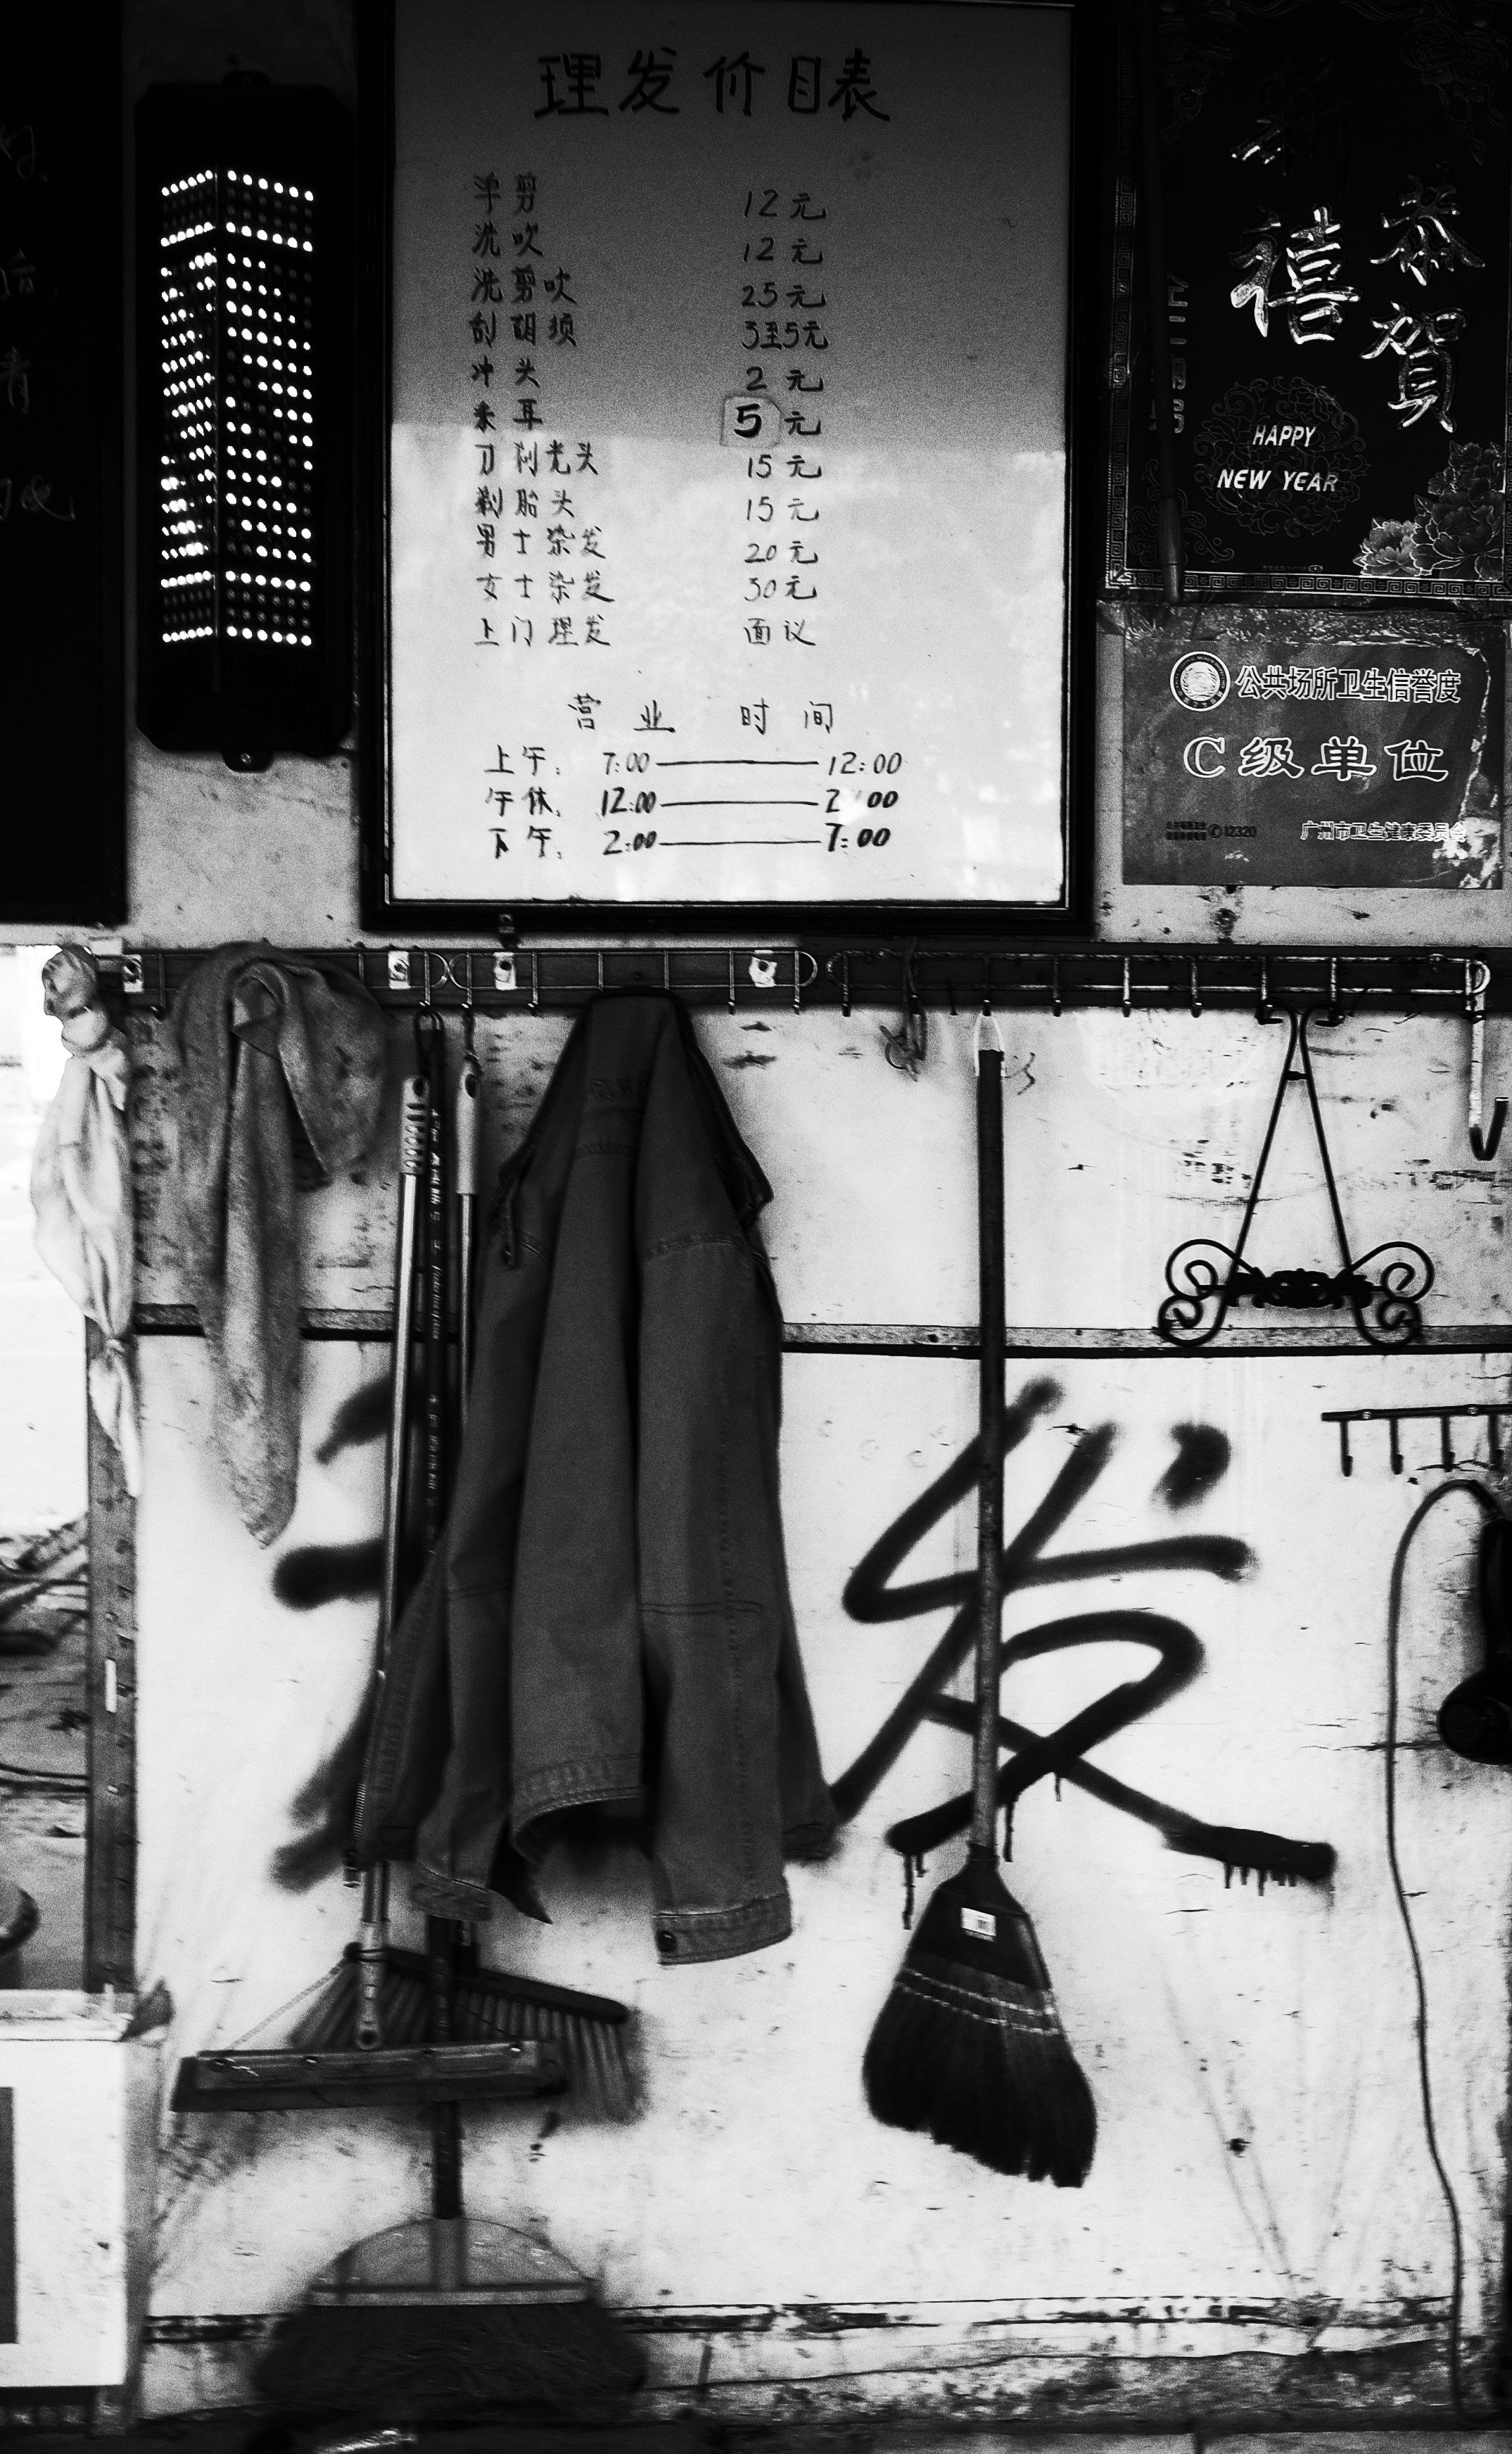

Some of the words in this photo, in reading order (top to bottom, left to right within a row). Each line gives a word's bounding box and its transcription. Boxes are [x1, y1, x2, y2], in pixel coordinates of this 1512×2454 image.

[534, 46, 890, 122] 理发价目表
[471, 221, 544, 258] 洗吹
[471, 265, 578, 305] 洗剪吹
[469, 311, 577, 348] 刮胡须
[742, 320, 830, 350] 3至5元
[471, 355, 540, 388] 冲头
[1252, 424, 1319, 448] HAPPY
[1216, 469, 1273, 491] NEW
[1282, 469, 1338, 493] YEAR
[476, 524, 606, 559] 男士染发
[476, 570, 616, 605] 女士染发
[474, 614, 611, 647] 上门理发
[743, 618, 816, 646] 面议
[1235, 665, 1462, 704] 公共场所卫生信誉度
[567, 693, 834, 735] 营业时间
[1183, 735, 1449, 782] C级单位
[825, 788, 899, 813] 200
[1224, 825, 1257, 837] 12320
